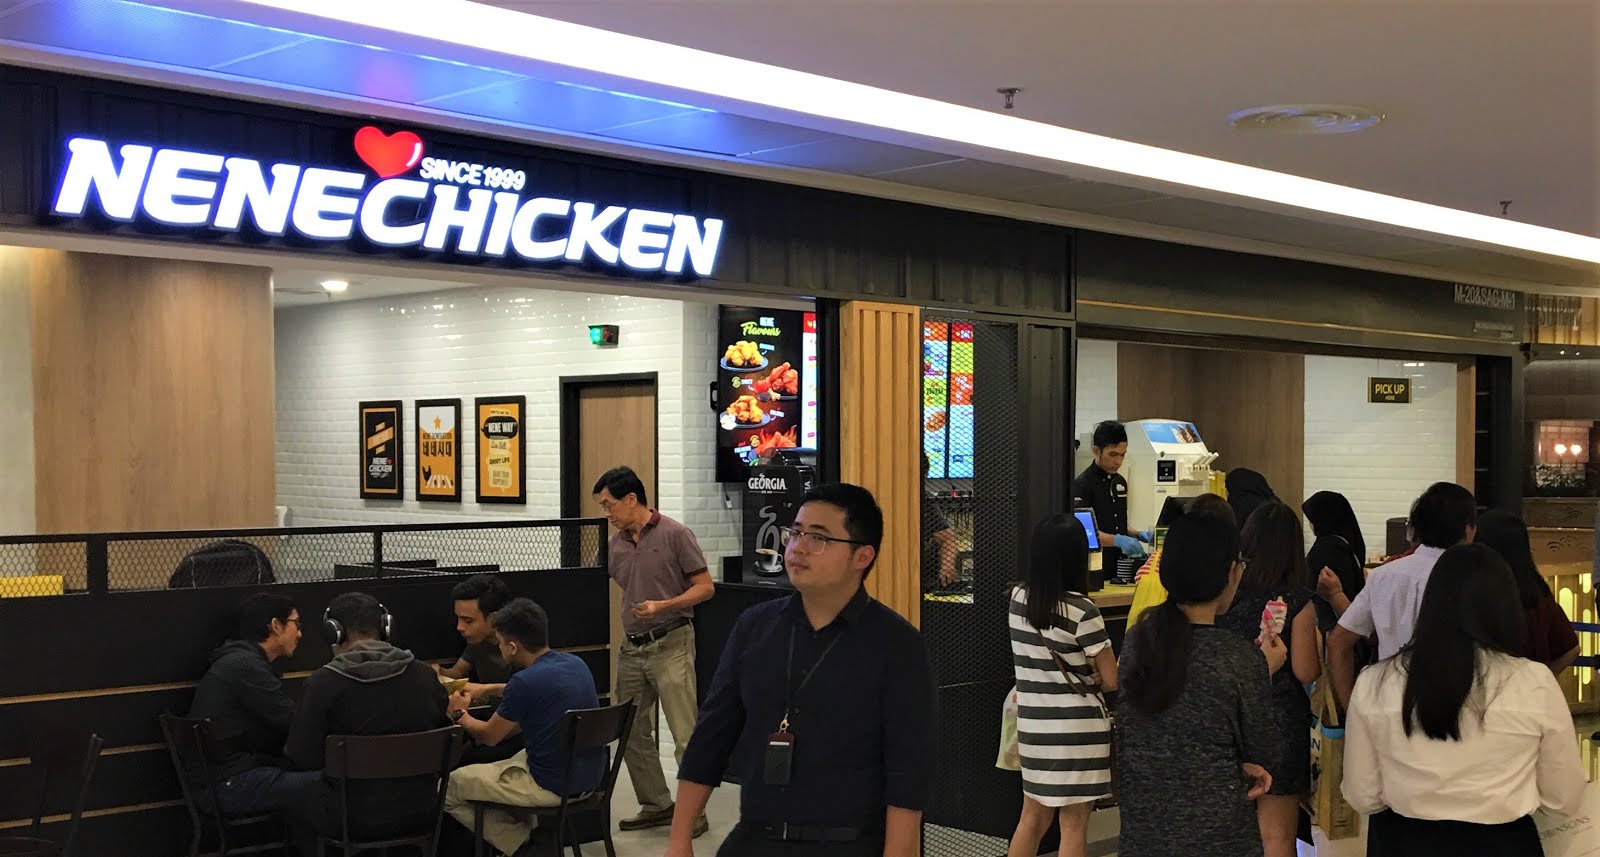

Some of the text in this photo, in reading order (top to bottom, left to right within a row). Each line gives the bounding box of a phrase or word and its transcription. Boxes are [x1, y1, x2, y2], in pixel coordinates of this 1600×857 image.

[420, 157, 526, 191] SINCE 1999
[1375, 384, 1405, 394] PICK UP
[488, 421, 514, 433] NENE WAY
[369, 465, 392, 473] CHICKEN
[748, 476, 787, 490] GEORGIA
